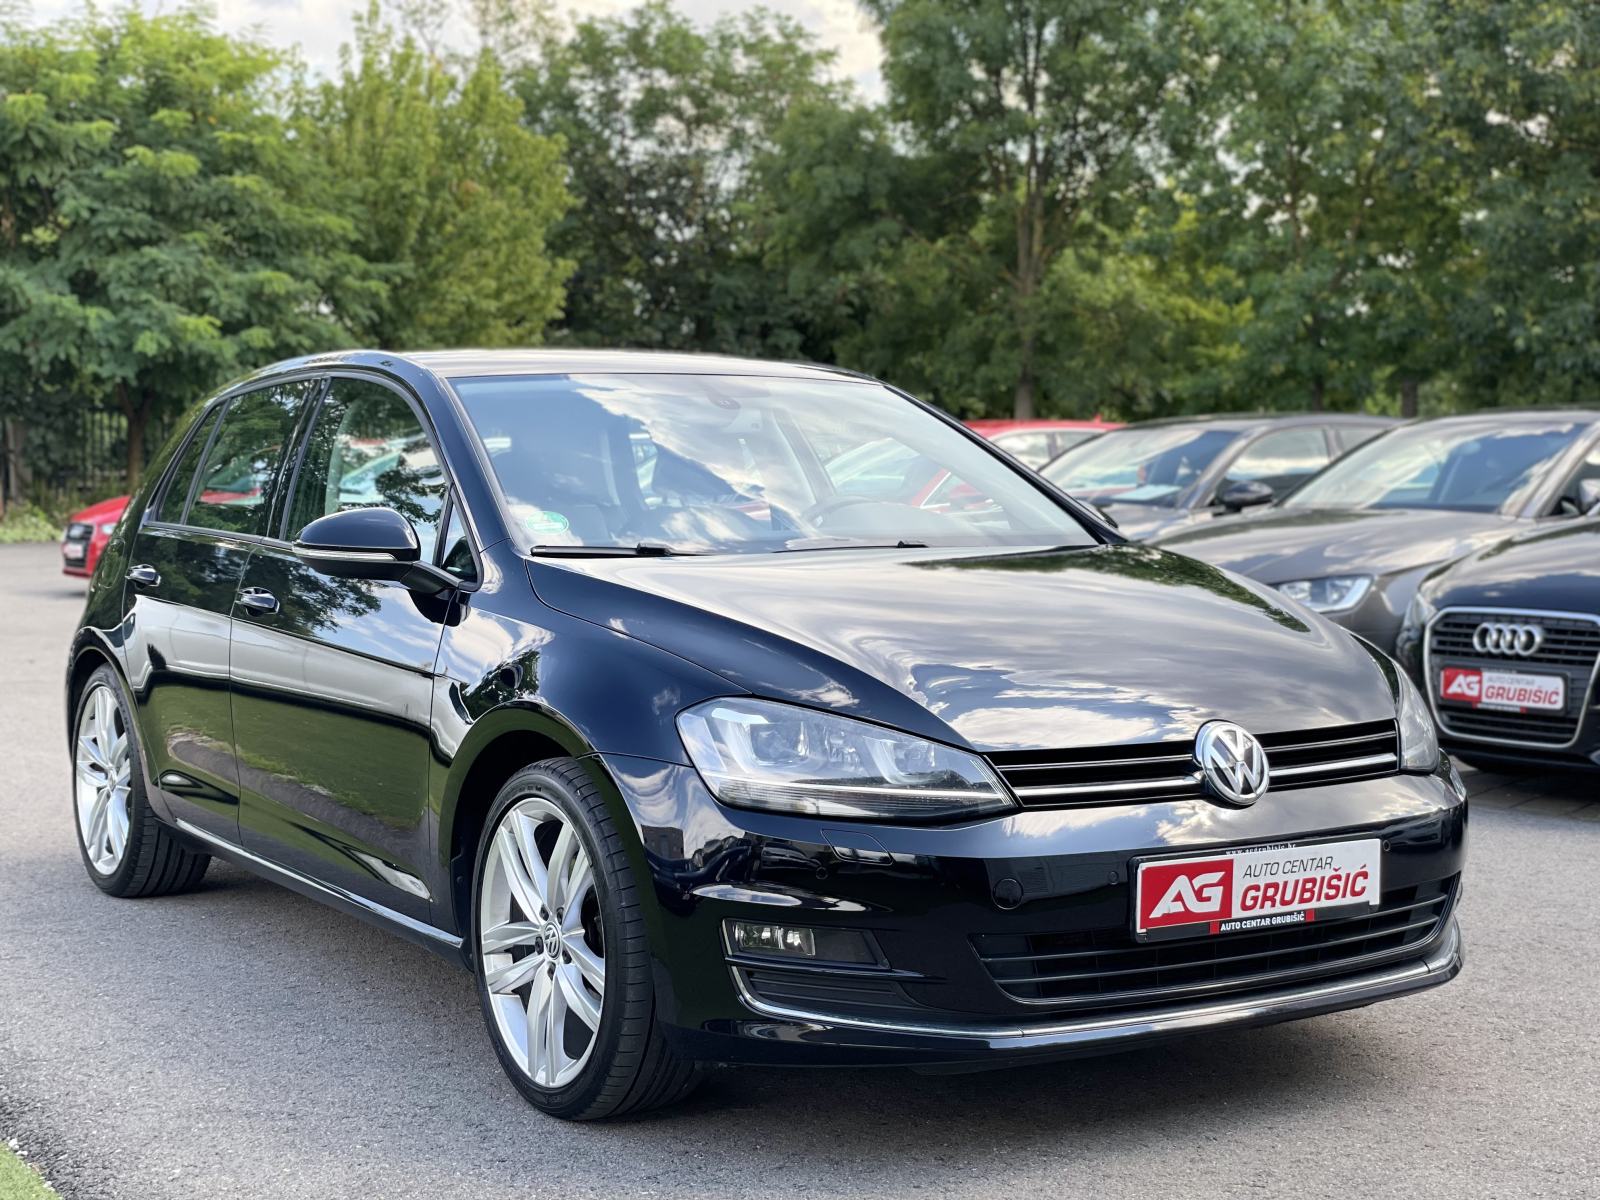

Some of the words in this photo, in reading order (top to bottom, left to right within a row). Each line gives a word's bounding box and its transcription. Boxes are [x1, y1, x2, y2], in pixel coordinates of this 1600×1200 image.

[1446, 674, 1480, 697] AG
[1205, 724, 1266, 801] VW
[1243, 861, 1280, 879] AUTO
[1282, 856, 1334, 875] CENTAR
[1149, 871, 1227, 919] AG
[1240, 864, 1369, 912] GRUBIŠIĆ
[1220, 921, 1241, 931] AUTO
[1242, 918, 1271, 929] CENTAR
[1271, 911, 1305, 925] GRUBIŠIĆ
